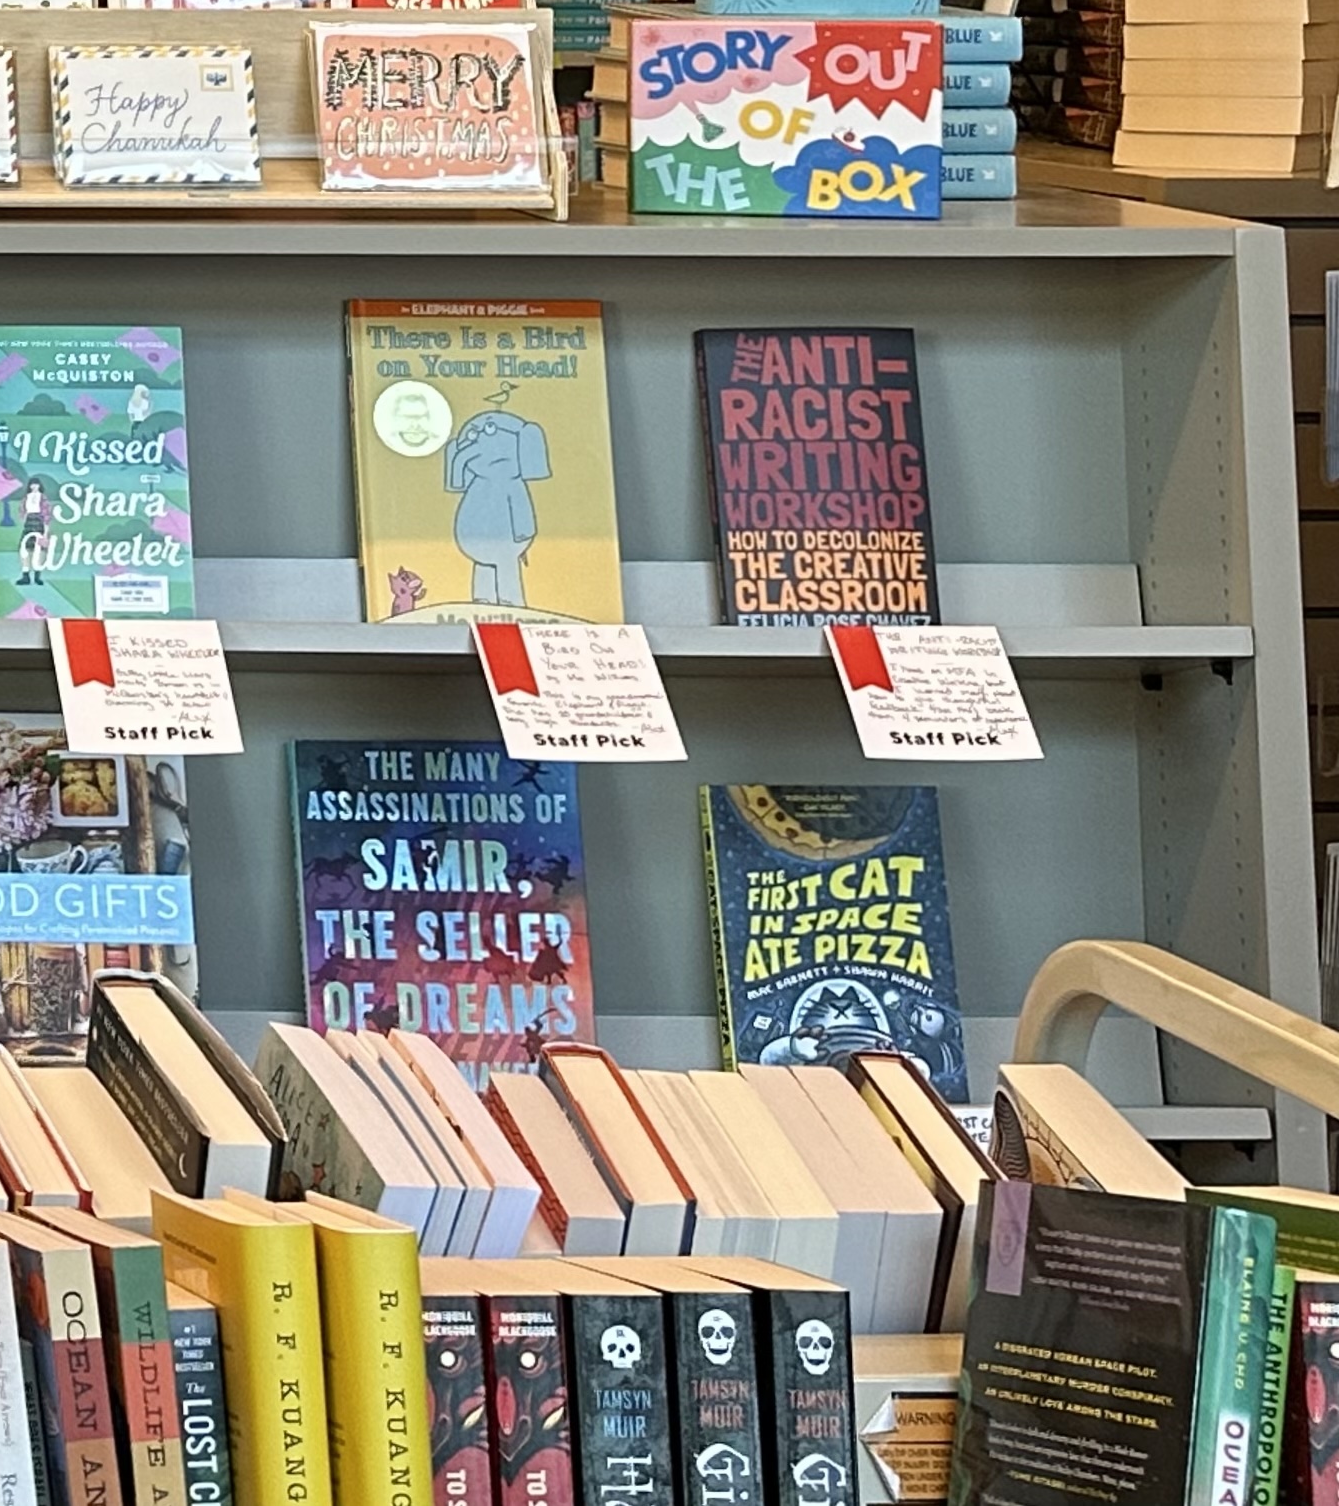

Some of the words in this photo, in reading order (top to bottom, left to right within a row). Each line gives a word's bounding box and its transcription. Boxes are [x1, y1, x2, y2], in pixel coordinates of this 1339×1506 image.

[326, 49, 524, 112] MERRY
[639, 29, 796, 99] STORY
[824, 30, 933, 91] OUT
[87, 83, 187, 124] Happy
[738, 100, 816, 145] OF
[82, 122, 225, 153] Chanukah
[335, 116, 512, 163] CHRISTMAS
[644, 152, 751, 211] THE
[807, 161, 927, 210] BOX
[367, 326, 451, 349] There
[460, 326, 487, 349] Is
[497, 333, 516, 349] a
[523, 326, 587, 349] Bird
[33, 369, 134, 383] McQUISTON
[54, 353, 111, 367] CASEY
[377, 360, 411, 377] on
[420, 355, 487, 378] Your
[495, 355, 578, 378] Head!
[732, 336, 763, 382] THE
[761, 336, 907, 384] ANTI-
[722, 390, 911, 440] RACIST
[13, 431, 31, 463] I
[41, 430, 165, 477] Kissed
[722, 444, 921, 492] WRITING
[53, 483, 166, 523] Shara
[724, 493, 925, 530] WORKSHOP
[19, 530, 184, 573] Wheeler
[729, 532, 766, 550] HOW
[771, 532, 795, 549] TO
[800, 532, 924, 551] DECOLONIZE
[731, 555, 785, 578] THE
[793, 554, 927, 580] CREATIVE
[735, 582, 927, 612] CLASSROOM
[890, 733, 945, 746] Staff
[954, 733, 1001, 748] Pick
[365, 751, 414, 782] THE
[424, 748, 501, 782] MANY
[307, 790, 526, 823] ASSASSINATIONS
[535, 792, 567, 823] OF
[361, 840, 535, 896] SAMIR,
[748, 871, 785, 886] THE
[748, 879, 823, 912] FIRST
[830, 856, 924, 900] CAT
[56, 881, 179, 920] GIFTS
[750, 913, 786, 934] IN
[793, 902, 924, 934] SPACE
[316, 909, 398, 962] THE
[416, 909, 572, 965] SELLER
[744, 936, 805, 981] ATE
[813, 933, 932, 979] PIZZA
[321, 982, 377, 1033] OF
[397, 982, 575, 1038] DREAMS
[62, 1291, 98, 1431] OCEAN
[132, 1300, 165, 1467] WILDLIFE
[897, 1412, 956, 1426] WARNING
